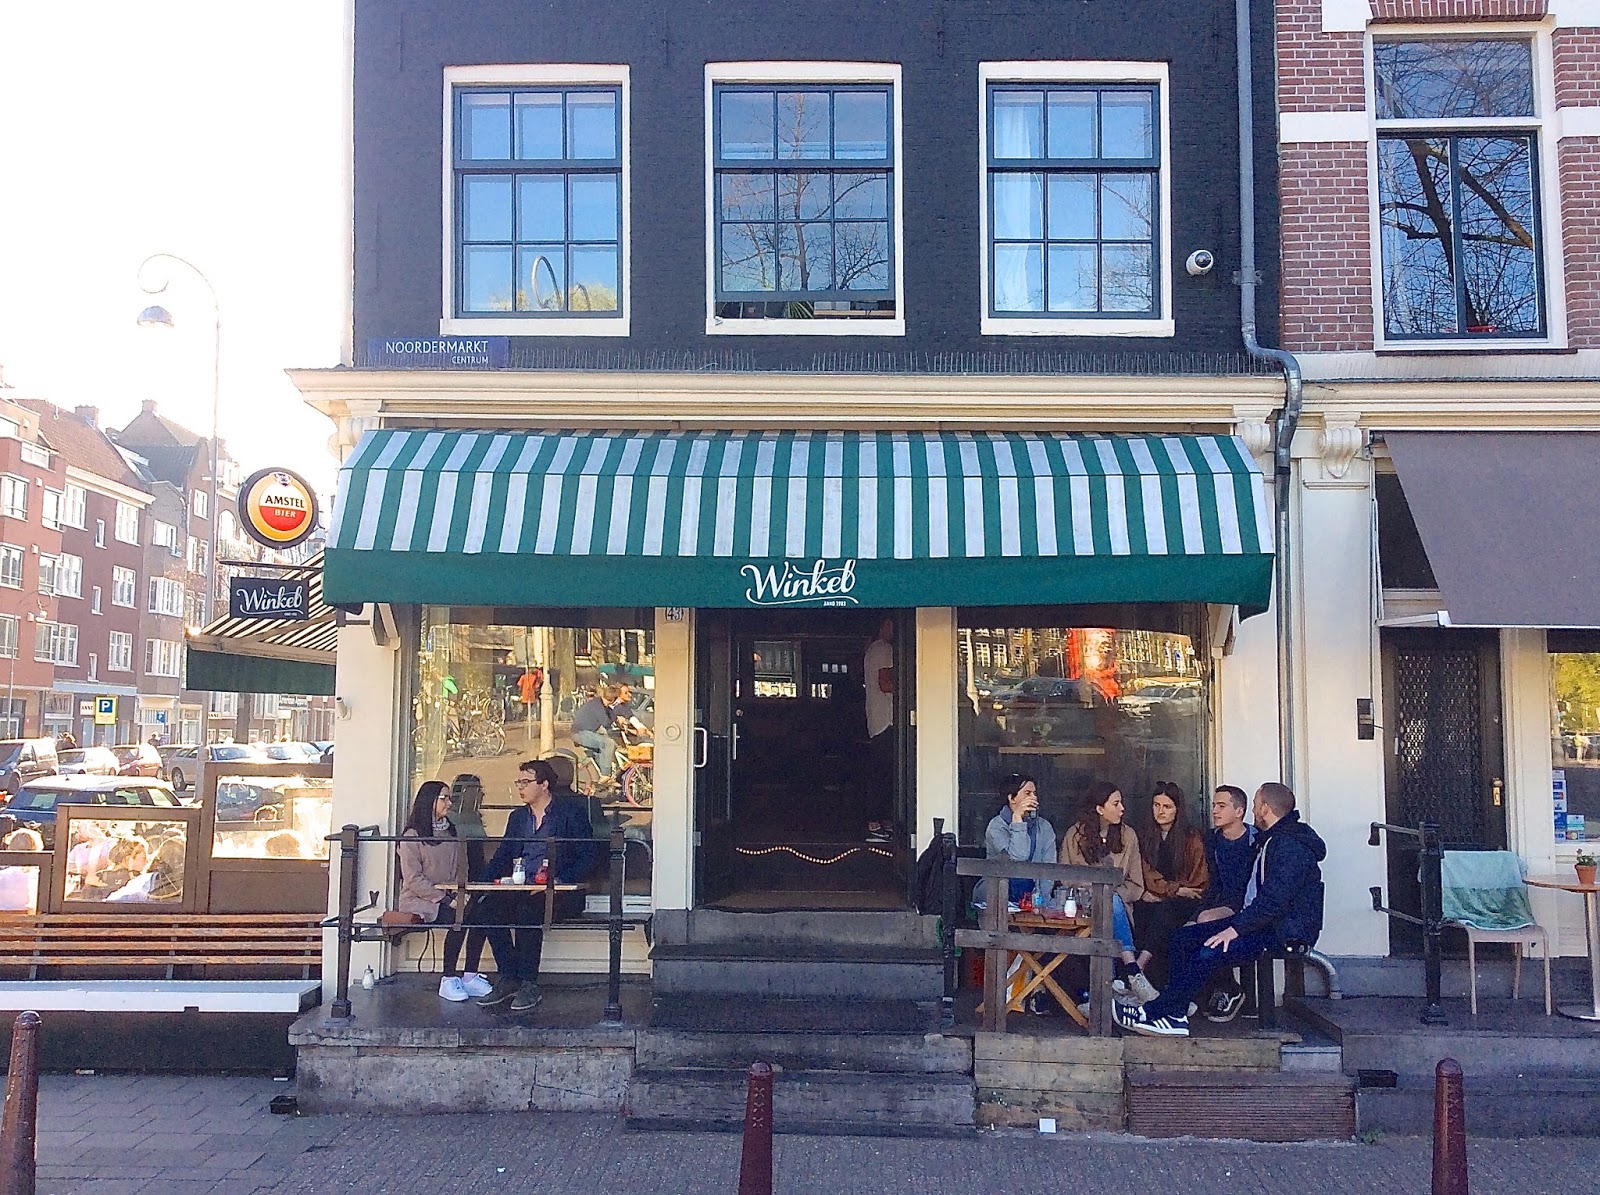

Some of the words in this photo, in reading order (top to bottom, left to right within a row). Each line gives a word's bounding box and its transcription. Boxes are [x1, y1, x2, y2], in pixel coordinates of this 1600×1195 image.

[385, 341, 488, 354] NOORDERMARKT
[451, 356, 489, 365] CENTRUM
[265, 495, 305, 508] AMSTEL
[274, 509, 296, 518] BIER
[740, 559, 856, 600] Winkel
[236, 585, 303, 611] Winkel
[667, 607, 681, 621] 43
[101, 701, 110, 711] P
